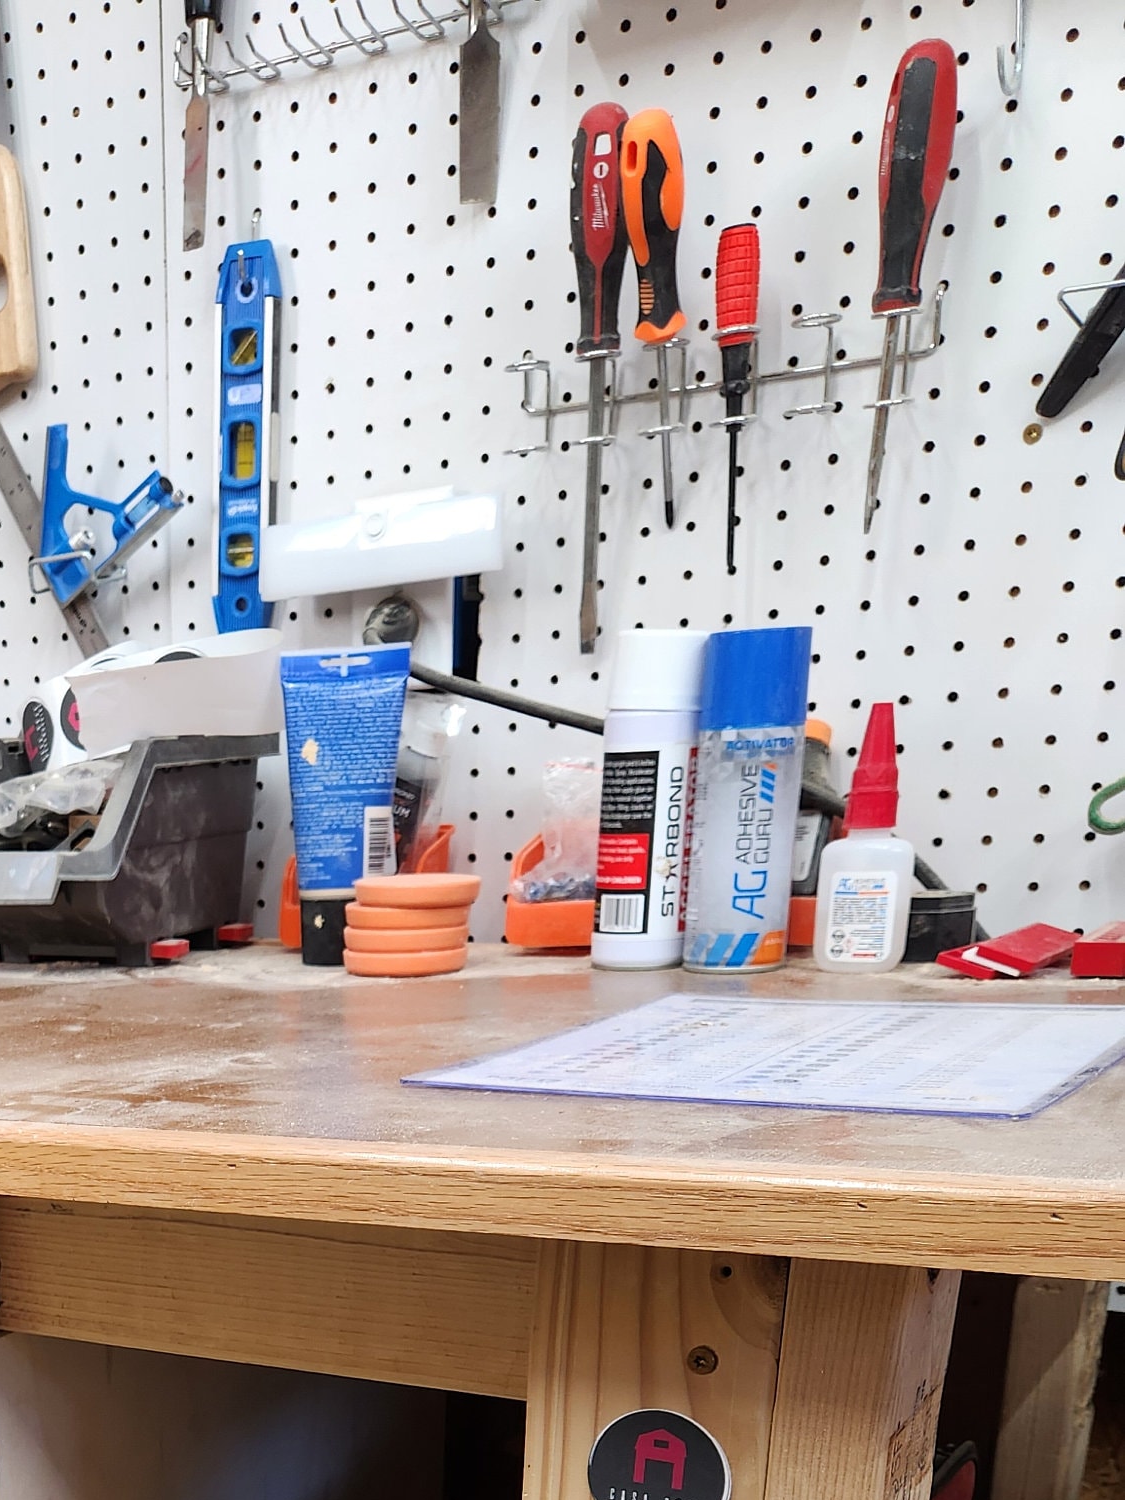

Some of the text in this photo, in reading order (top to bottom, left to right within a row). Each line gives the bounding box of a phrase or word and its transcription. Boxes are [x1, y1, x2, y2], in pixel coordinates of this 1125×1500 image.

[727, 737, 794, 751] ACTIVATOR
[736, 764, 759, 865] ADHESIVE
[754, 808, 773, 864] GURU
[732, 870, 768, 920] AG
